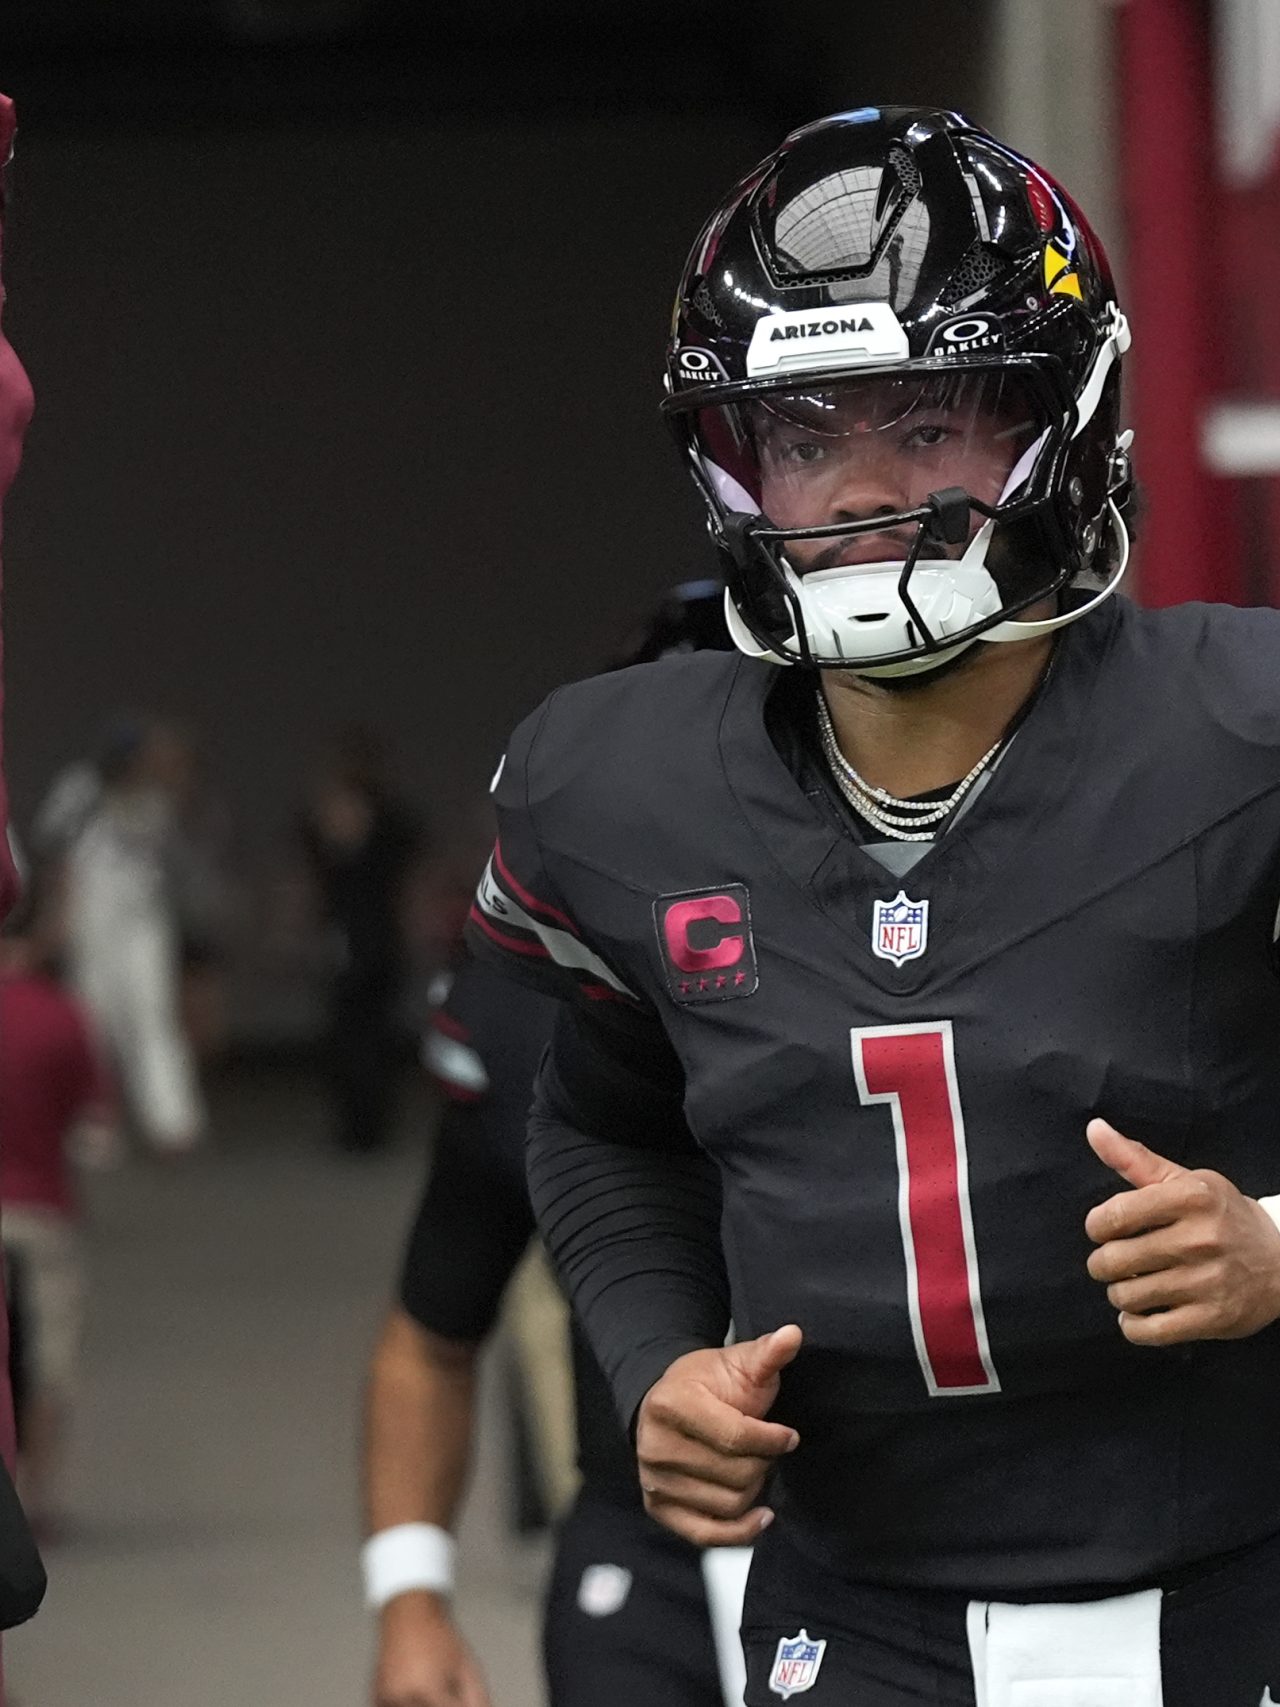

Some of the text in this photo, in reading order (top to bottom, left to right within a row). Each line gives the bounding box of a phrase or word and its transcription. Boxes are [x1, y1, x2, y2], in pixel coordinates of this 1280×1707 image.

[769, 317, 875, 342] ARIZONA
[933, 333, 1003, 357] OAKLEY
[679, 369, 720, 381] OAKLEY
[664, 895, 745, 974] C
[881, 926, 918, 953] NFL
[850, 1020, 1001, 1397] 1
[778, 1660, 808, 1685] NFL
